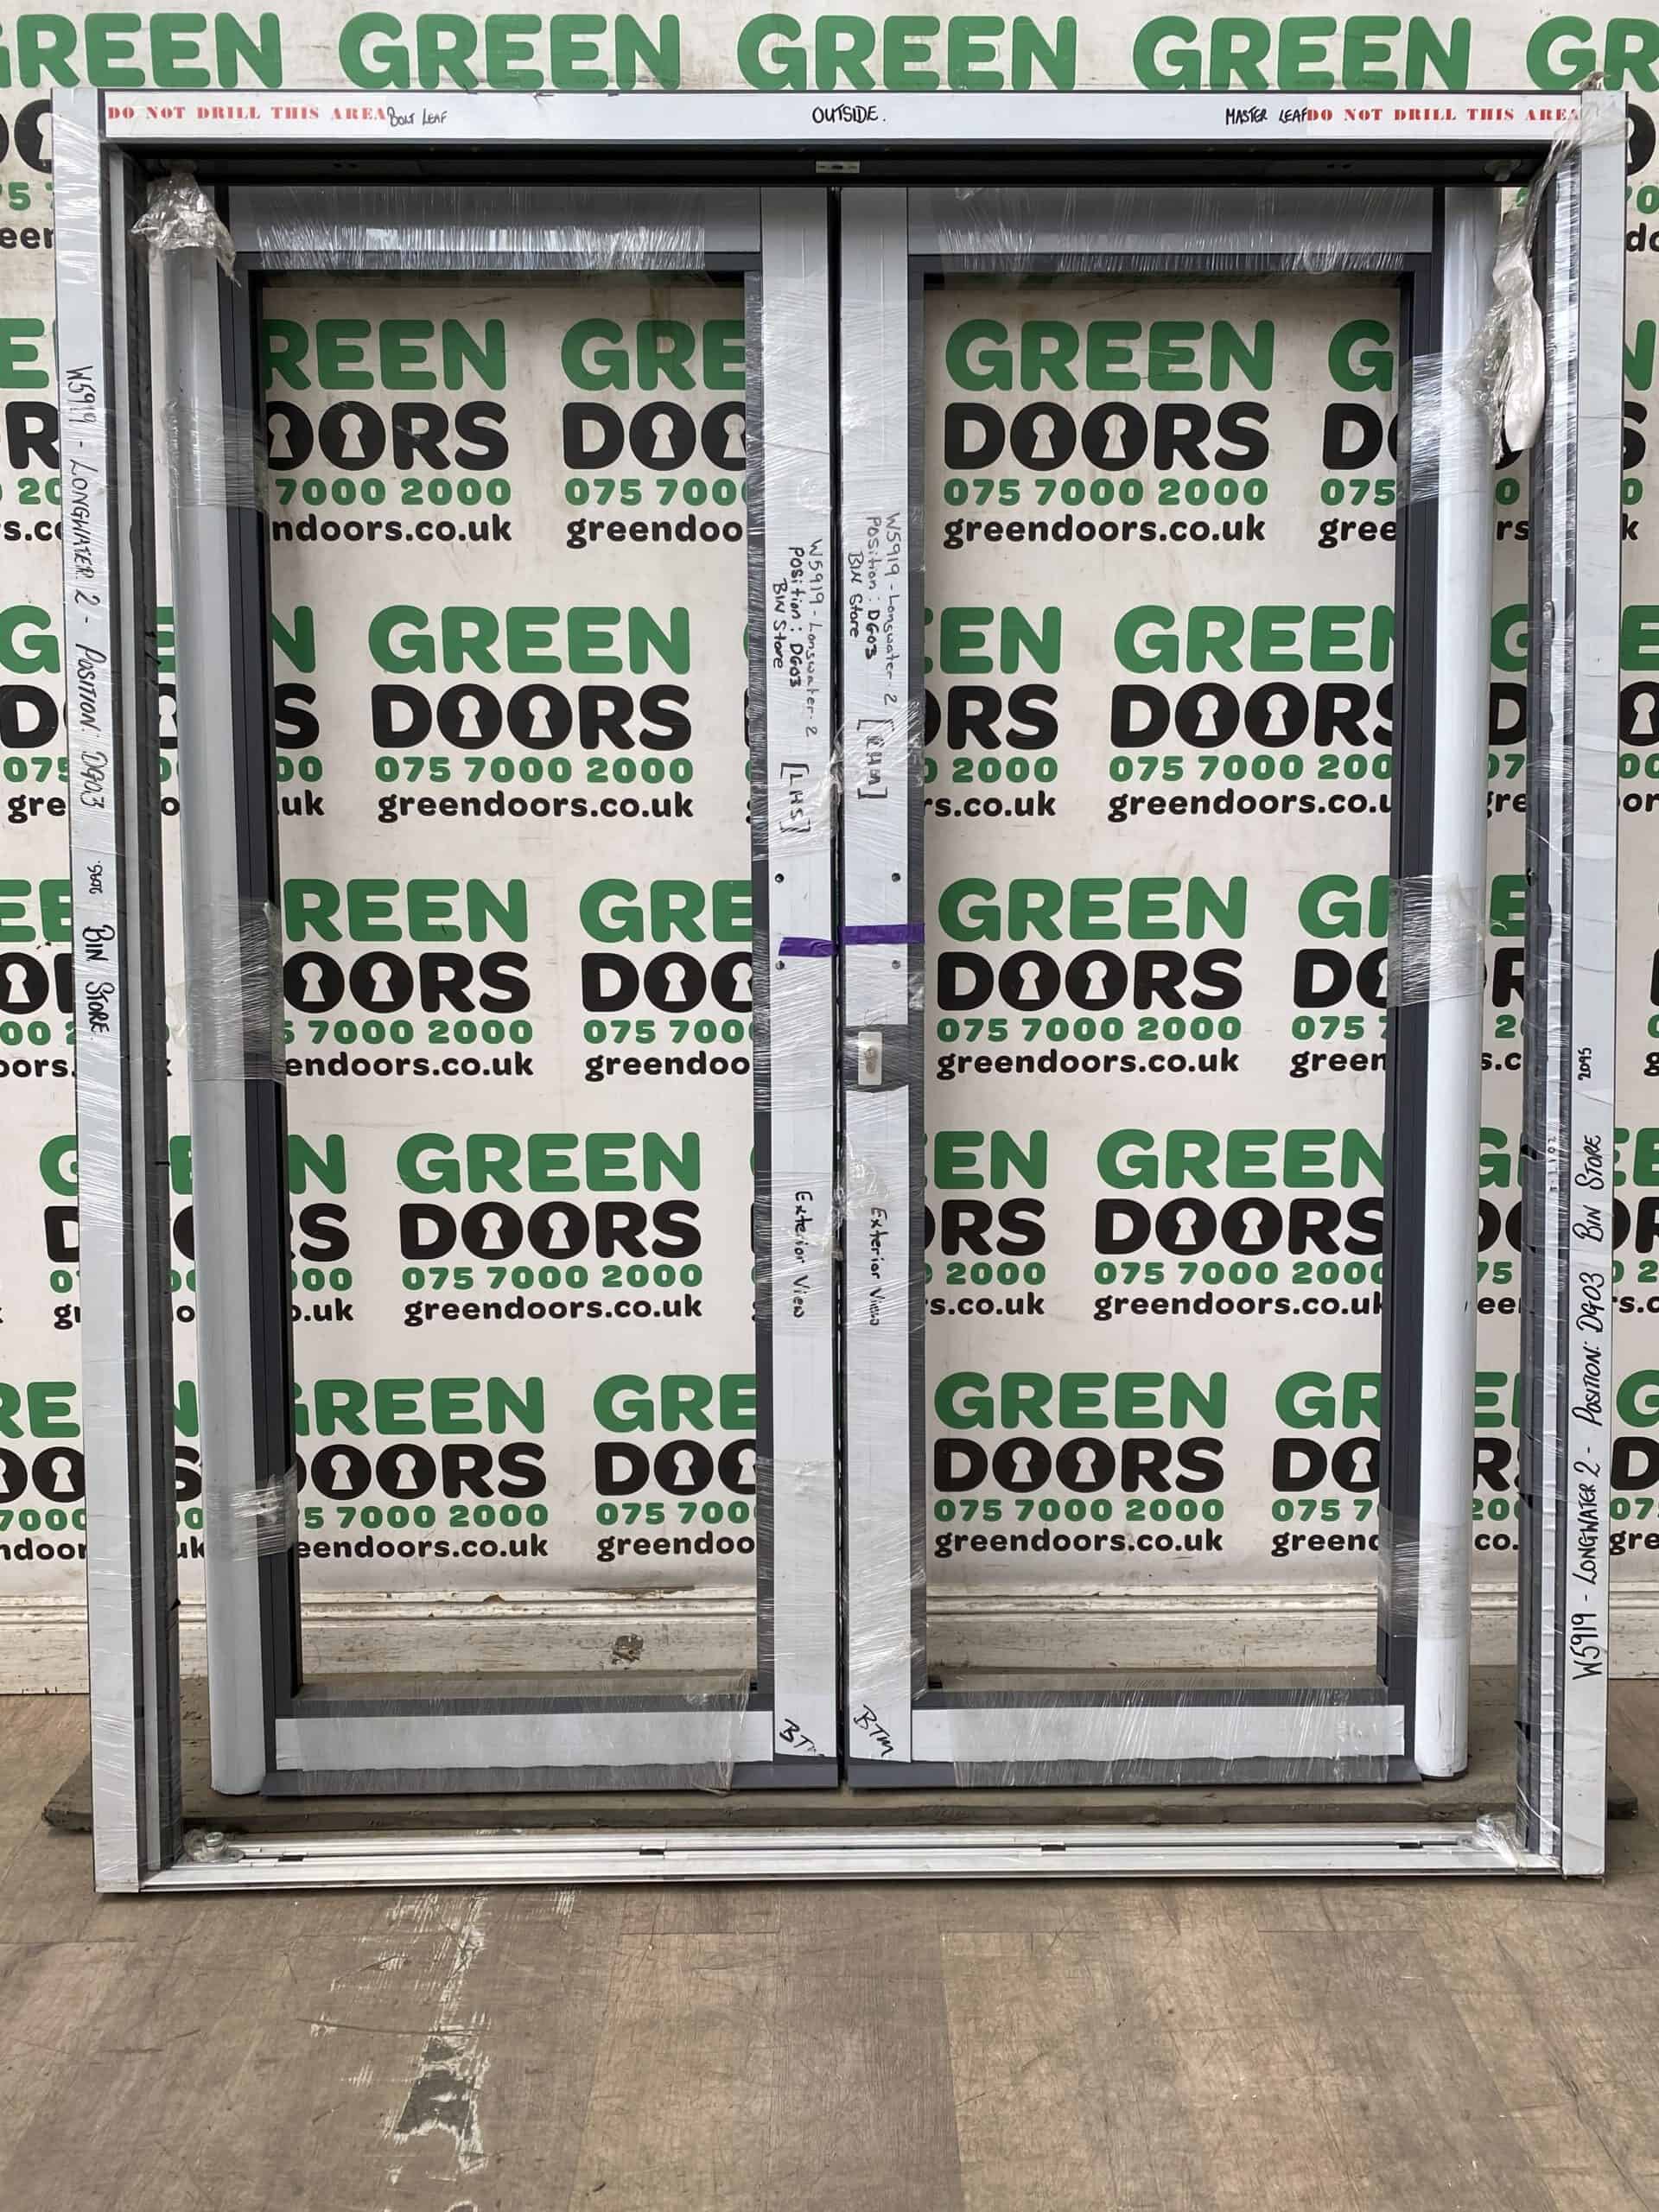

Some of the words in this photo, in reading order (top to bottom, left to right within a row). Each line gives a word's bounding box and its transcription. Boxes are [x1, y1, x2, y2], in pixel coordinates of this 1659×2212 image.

[0, 12, 283, 88] REEN
[338, 12, 681, 91] GREEN
[736, 13, 1078, 91] GREEN
[1133, 14, 1471, 91] GREEN
[107, 106, 135, 120] DO
[146, 105, 187, 120] NOT
[196, 106, 261, 119] DRILL
[270, 105, 320, 119] THIS
[330, 105, 387, 120] AREA
[1225, 107, 1268, 125] MASTER
[1278, 108, 1308, 125] LEAF
[1307, 108, 1333, 122] DO
[1344, 108, 1383, 121] NOT
[1394, 107, 1457, 121] DRILL
[1466, 107, 1515, 121] THIS
[1524, 107, 1580, 121] AREA
[264, 318, 506, 391] REEN
[947, 321, 1275, 392] GREEN
[66, 365, 95, 424] W5919
[944, 401, 1269, 472] DOORS
[276, 478, 387, 505] 7000
[400, 477, 512, 505] 2000
[565, 478, 642, 505] 075
[945, 478, 1020, 505] 075
[1036, 478, 1144, 506] 7000
[1158, 477, 1268, 505] 2000
[70, 459, 99, 579] LONGWATER
[943, 513, 1265, 546] greendoors.co.uk
[884, 512, 901, 577] W5919
[808, 538, 825, 604] W5919
[849, 593, 864, 639] Store
[865, 609, 880, 660] DG03
[369, 604, 690, 675] GREEN
[773, 620, 787, 669] Store
[789, 643, 804, 688] DG03
[371, 683, 692, 751] DOORS
[374, 755, 451, 782] 075
[464, 755, 571, 783] 7000
[586, 755, 693, 785] 2000
[953, 756, 1058, 783] 2000
[1110, 754, 1184, 782] 075
[1198, 754, 1304, 781] 7000
[378, 790, 693, 823] greendoors.co.uk
[938, 875, 1248, 941] GREEN
[82, 925, 116, 962] BIN
[937, 948, 1243, 1012] DOORS
[309, 1019, 414, 1045] 7000
[428, 1019, 533, 1045] 2000
[582, 1018, 656, 1044] 075
[938, 1017, 1007, 1042] 075
[1022, 1017, 1124, 1042] 7000
[1138, 1015, 1242, 1042] 2000
[1292, 1014, 1363, 1042] 075
[936, 1047, 1239, 1081] greendoors.co.uk
[396, 1132, 701, 1194] GREEN
[1573, 1135, 1605, 1191] STORE
[399, 1199, 702, 1262] DOORS
[794, 1190, 814, 1264] Exterior
[868, 1206, 889, 1280] Exterior
[1572, 1205, 1605, 1243] BIN
[401, 1266, 473, 1291] 075
[487, 1265, 588, 1291] 7000
[601, 1263, 703, 1288] 2000
[948, 1262, 1046, 1287] 2000
[1094, 1261, 1163, 1286] 075
[1179, 1261, 1279, 1286] 7000
[404, 1294, 702, 1327] greendoors.co.uk
[1575, 1271, 1605, 1333] DG03
[935, 1371, 1228, 1429] GREEN
[933, 1436, 1224, 1493] DOORS
[1573, 1460, 1601, 1478] 2
[337, 1505, 435, 1529] 7000
[450, 1503, 548, 1528] 2000
[595, 1503, 664, 1526] 075
[937, 1500, 1000, 1522] 075
[1015, 1499, 1113, 1522] 7000
[1127, 1498, 1224, 1522] 2000
[1272, 1498, 1340, 1522] 075
[934, 1528, 1223, 1559] greendoors.co.uk
[1572, 1483, 1599, 1586] LONGWATER
[1570, 1612, 1603, 1680] W5919
[853, 1703, 894, 1758] BTM
